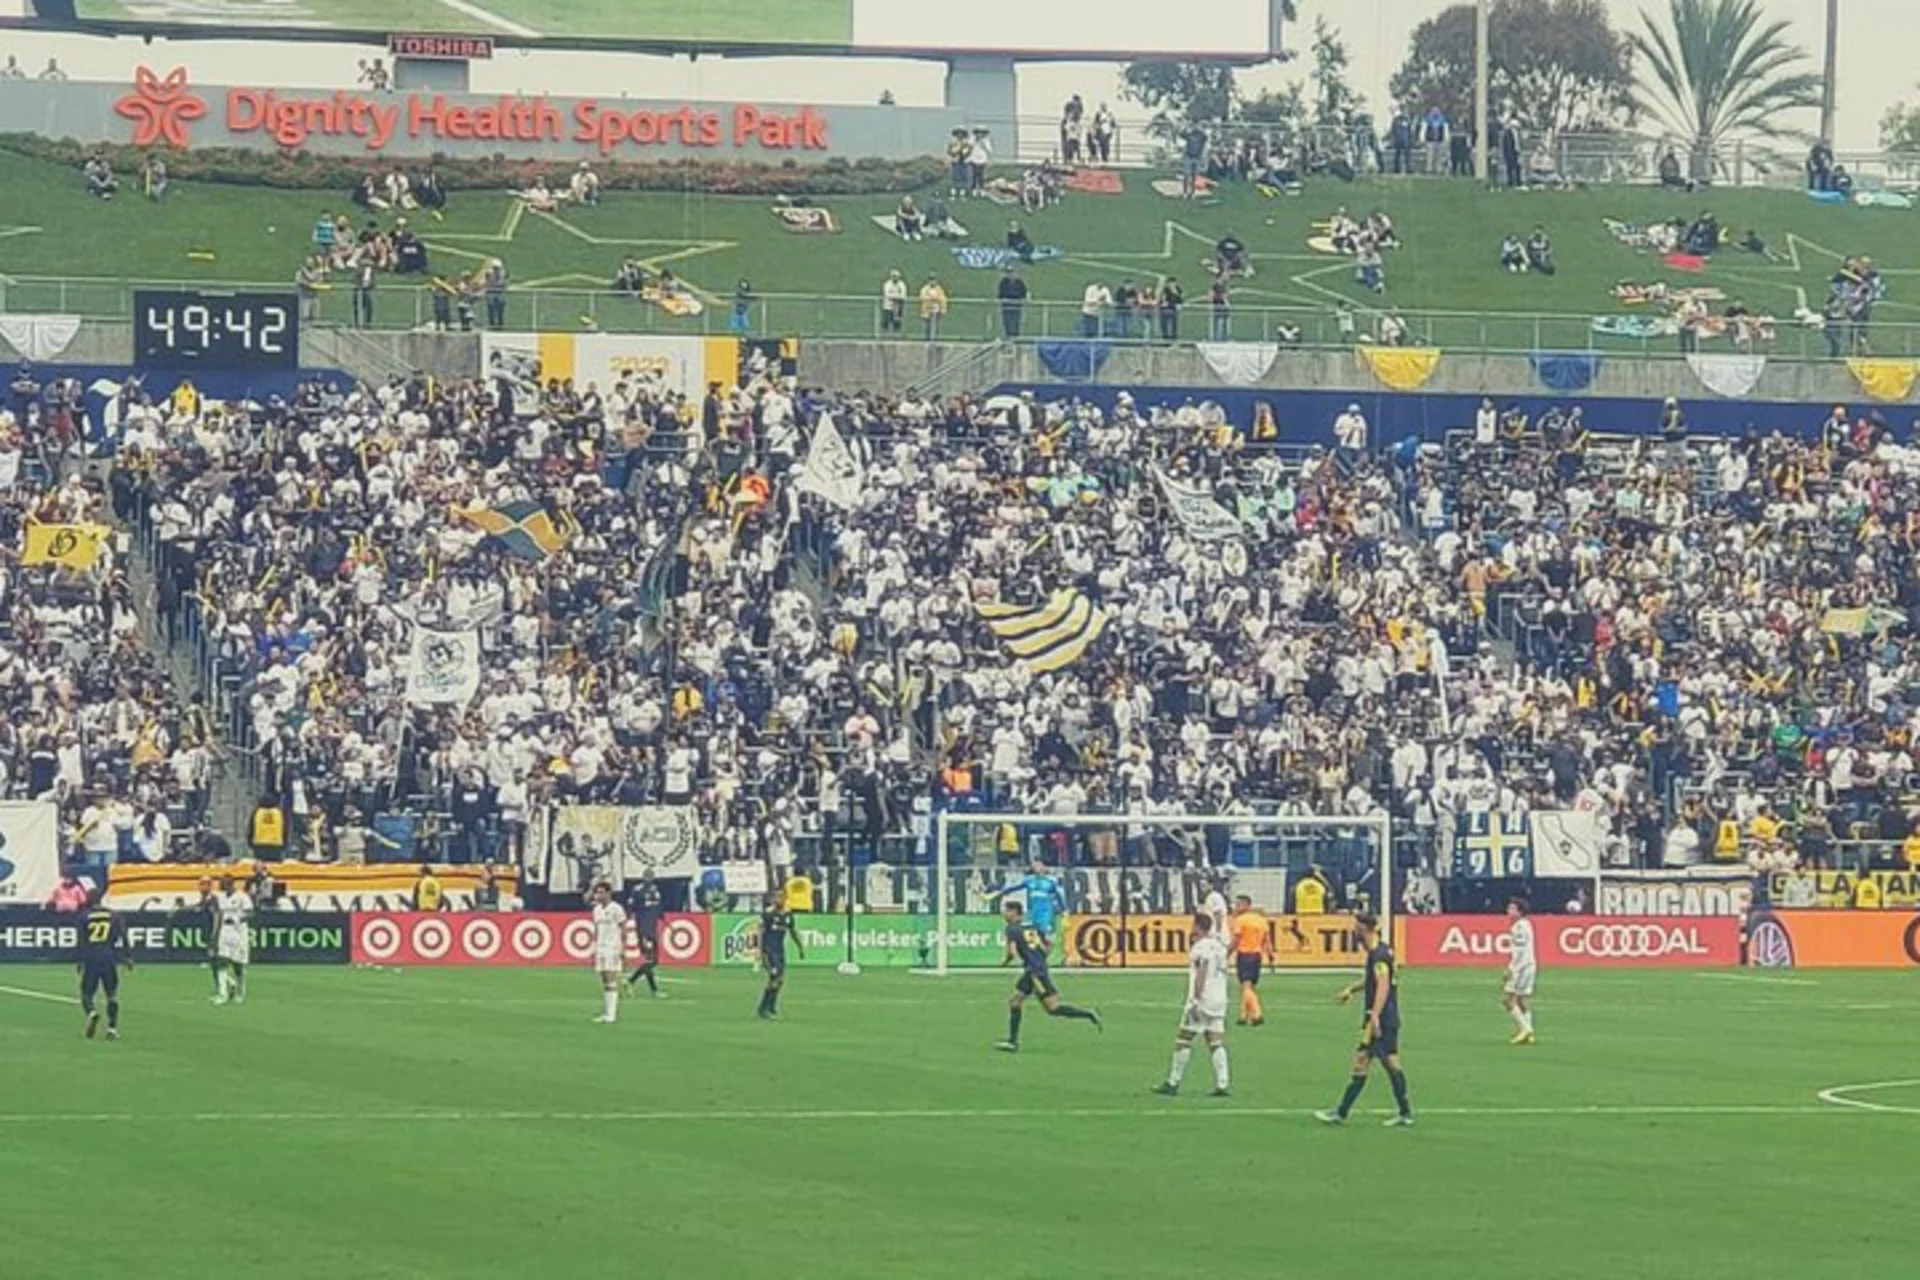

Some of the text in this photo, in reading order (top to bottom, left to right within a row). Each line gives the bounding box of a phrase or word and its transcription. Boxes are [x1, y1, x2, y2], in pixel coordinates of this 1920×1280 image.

[393, 38, 489, 55] TOSHIBA
[227, 88, 827, 155] Dignity Health Sports Park
[148, 305, 286, 353] 49:42
[0, 927, 342, 948] HERBFE NURITION
[88, 921, 110, 943] 27
[801, 930, 837, 946] The
[927, 930, 995, 947] Pcker
[1440, 927, 1513, 953] Aud
